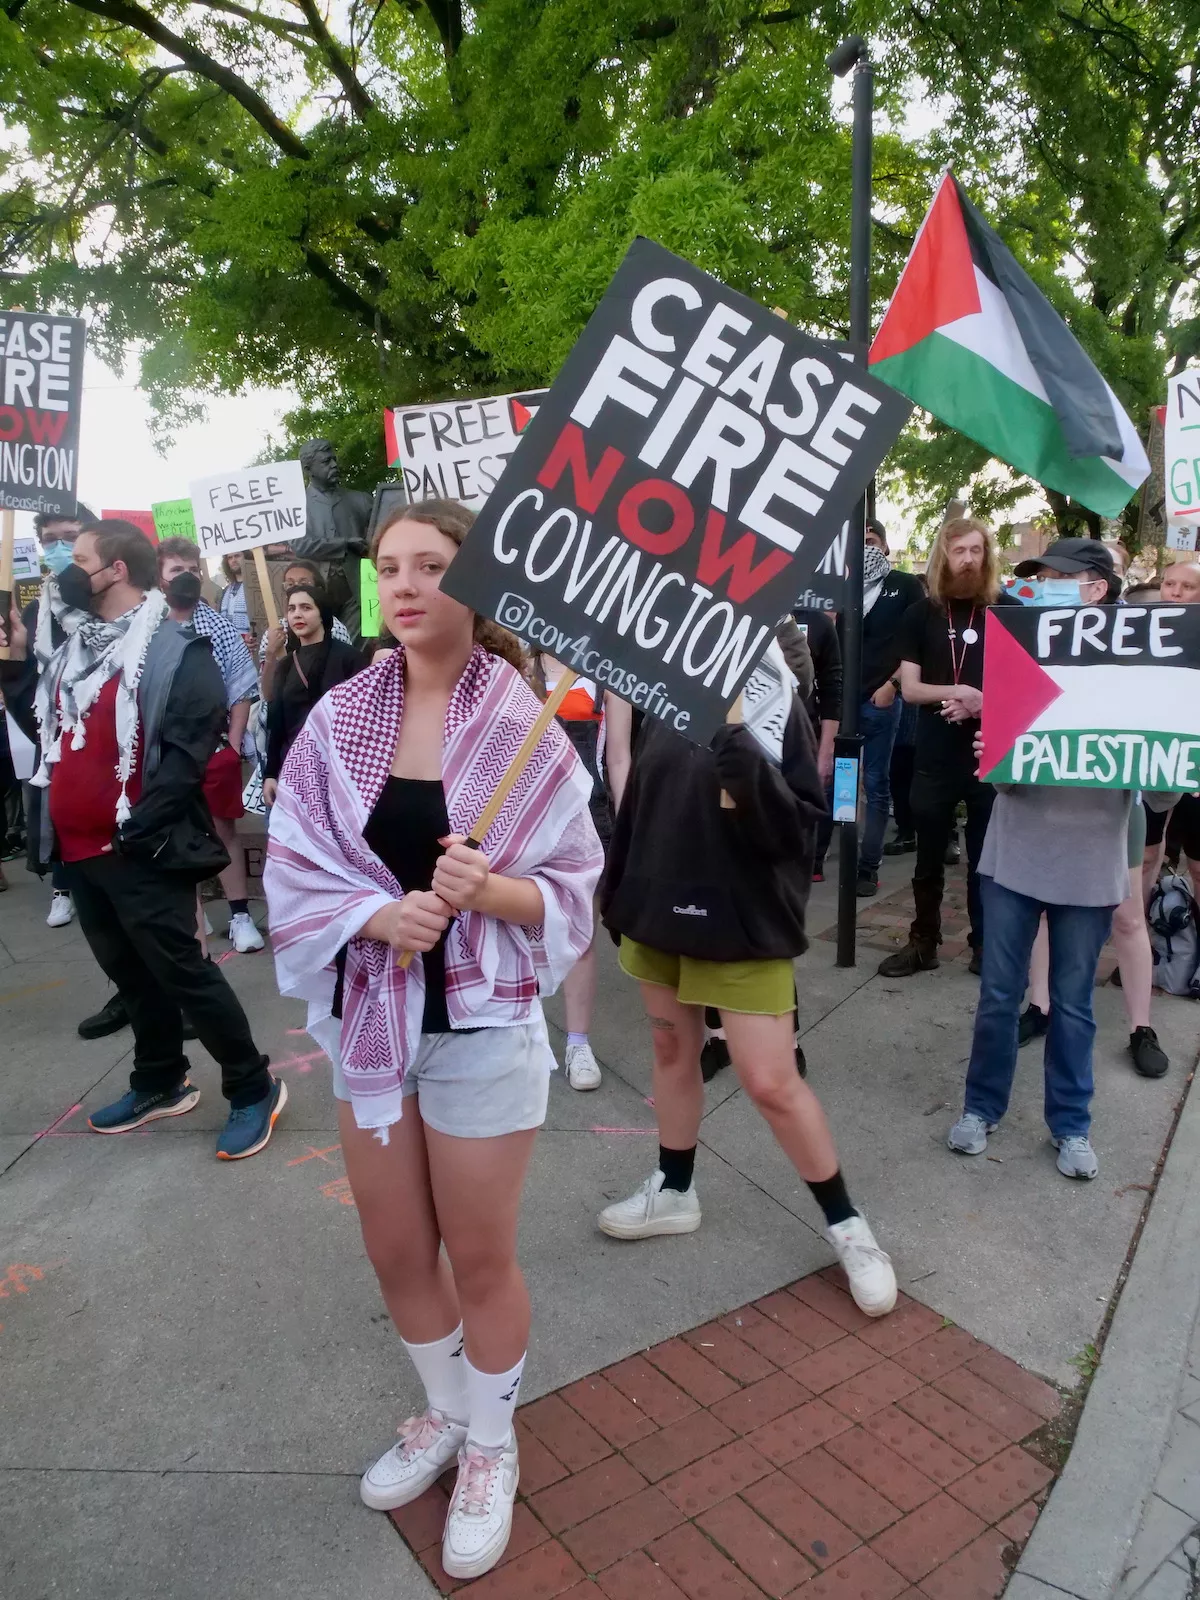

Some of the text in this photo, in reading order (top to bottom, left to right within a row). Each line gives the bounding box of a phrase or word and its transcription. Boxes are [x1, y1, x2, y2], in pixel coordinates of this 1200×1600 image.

[630, 277, 882, 467] CEASE
[401, 399, 505, 459] FREE
[569, 334, 842, 553] FIRE
[209, 476, 283, 509] FREE
[536, 421, 793, 603] NOW
[200, 507, 304, 550] PALESTINE
[493, 488, 770, 700] COVINGTON
[1037, 607, 1186, 658] FREE
[1011, 733, 1200, 789] PALESTINE
